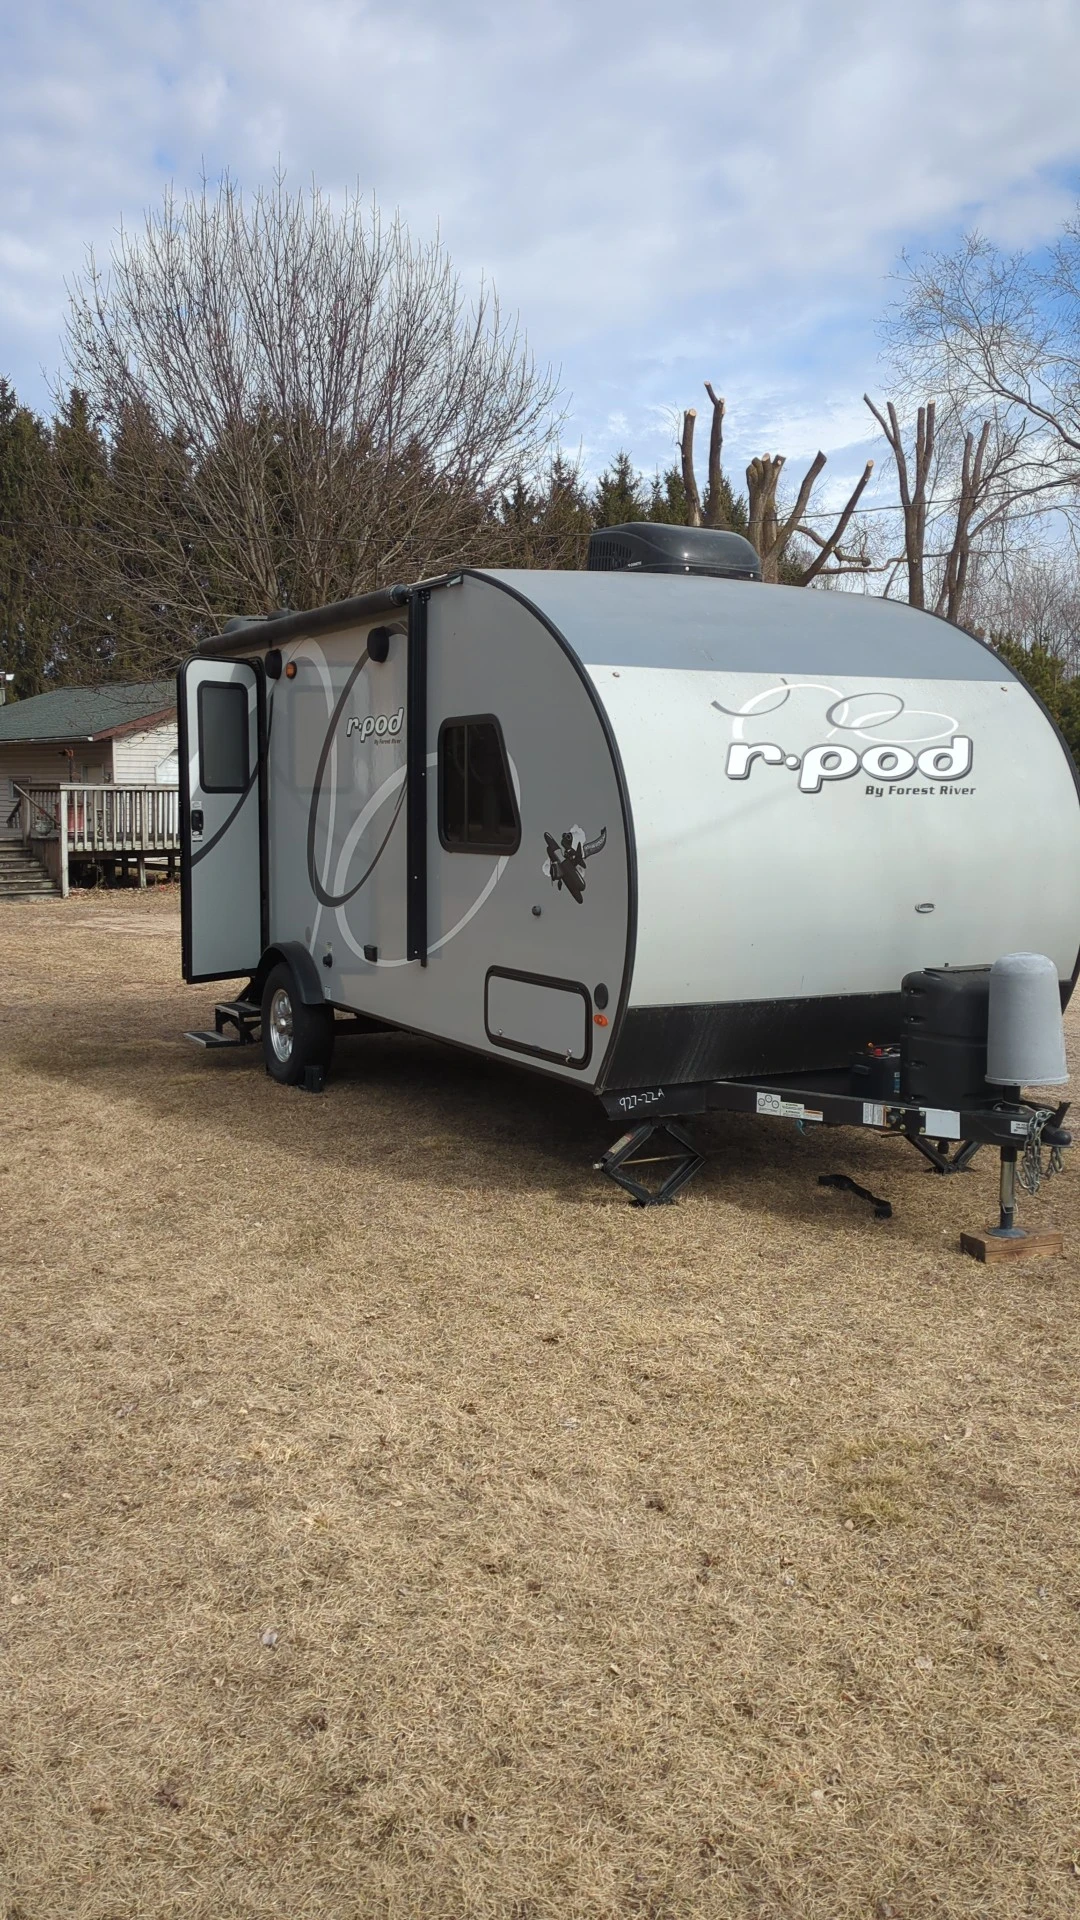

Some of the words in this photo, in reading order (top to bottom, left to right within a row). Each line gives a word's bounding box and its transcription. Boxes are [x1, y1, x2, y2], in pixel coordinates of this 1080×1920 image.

[865, 785, 883, 797] By
[888, 785, 935, 796] Forest
[939, 785, 976, 796] River
[619, 1088, 665, 1112] 927-22A
